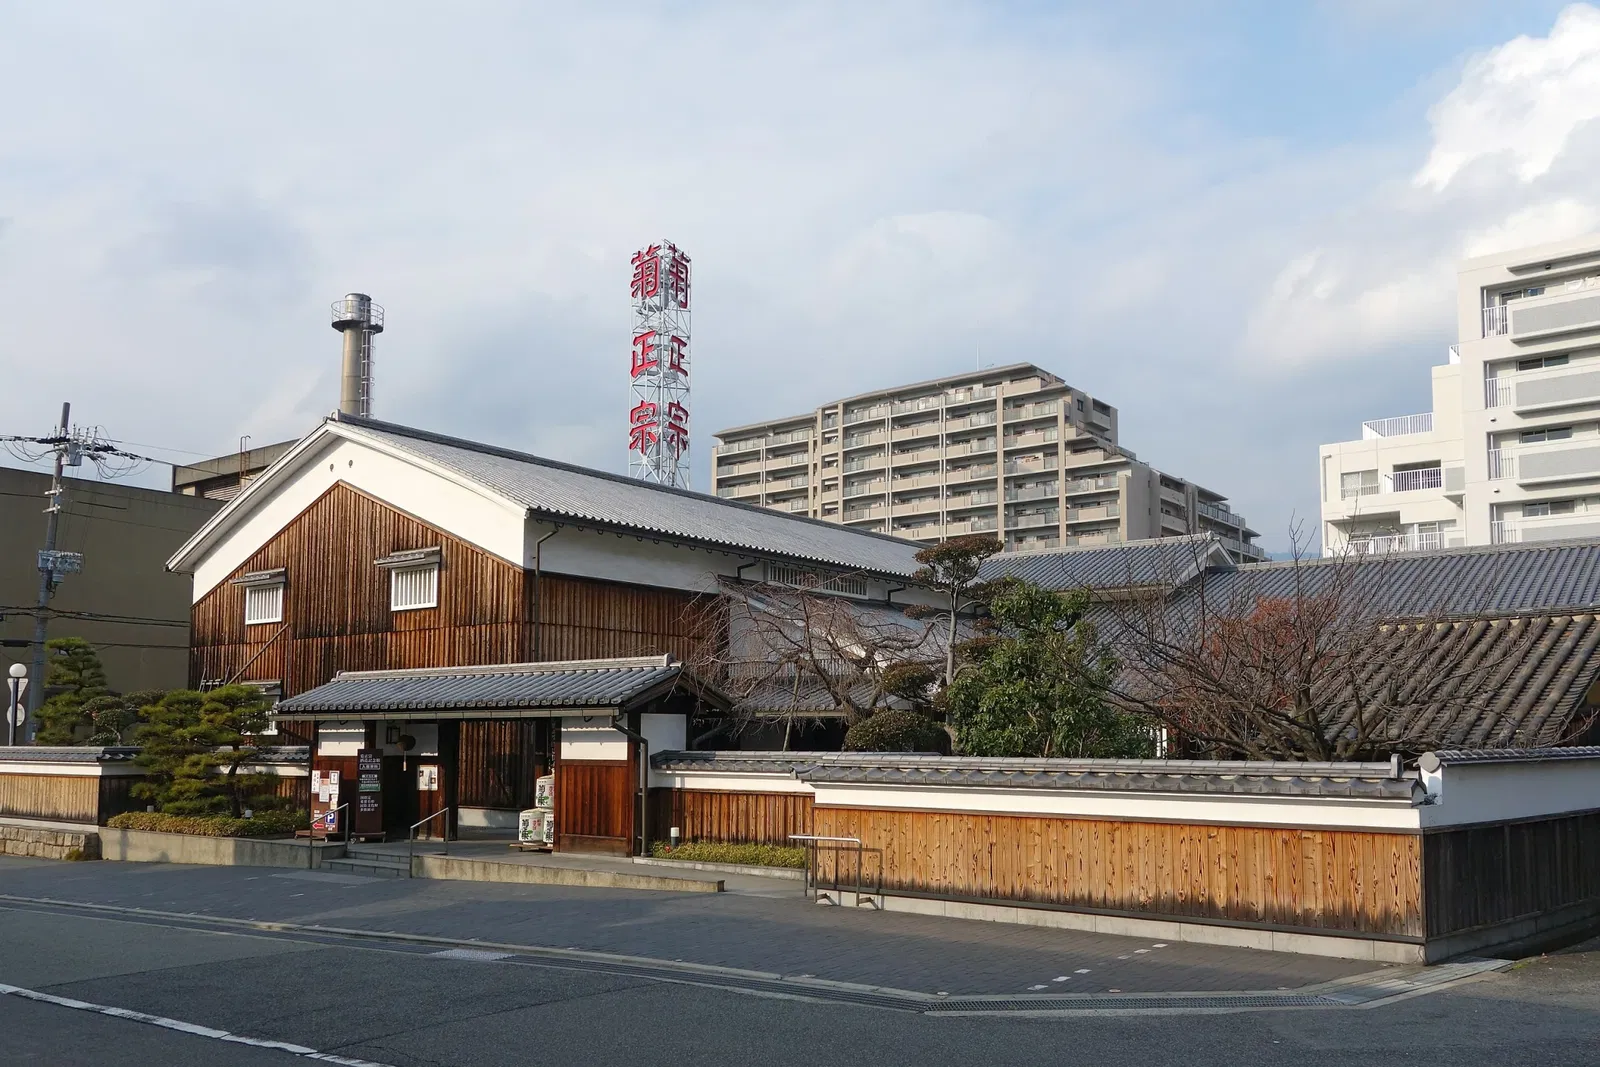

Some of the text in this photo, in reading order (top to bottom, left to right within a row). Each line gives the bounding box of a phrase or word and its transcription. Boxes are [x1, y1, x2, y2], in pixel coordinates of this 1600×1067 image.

[629, 244, 660, 454] 菊正宗
[668, 243, 690, 460] 菊正宗
[327, 813, 333, 822] P
